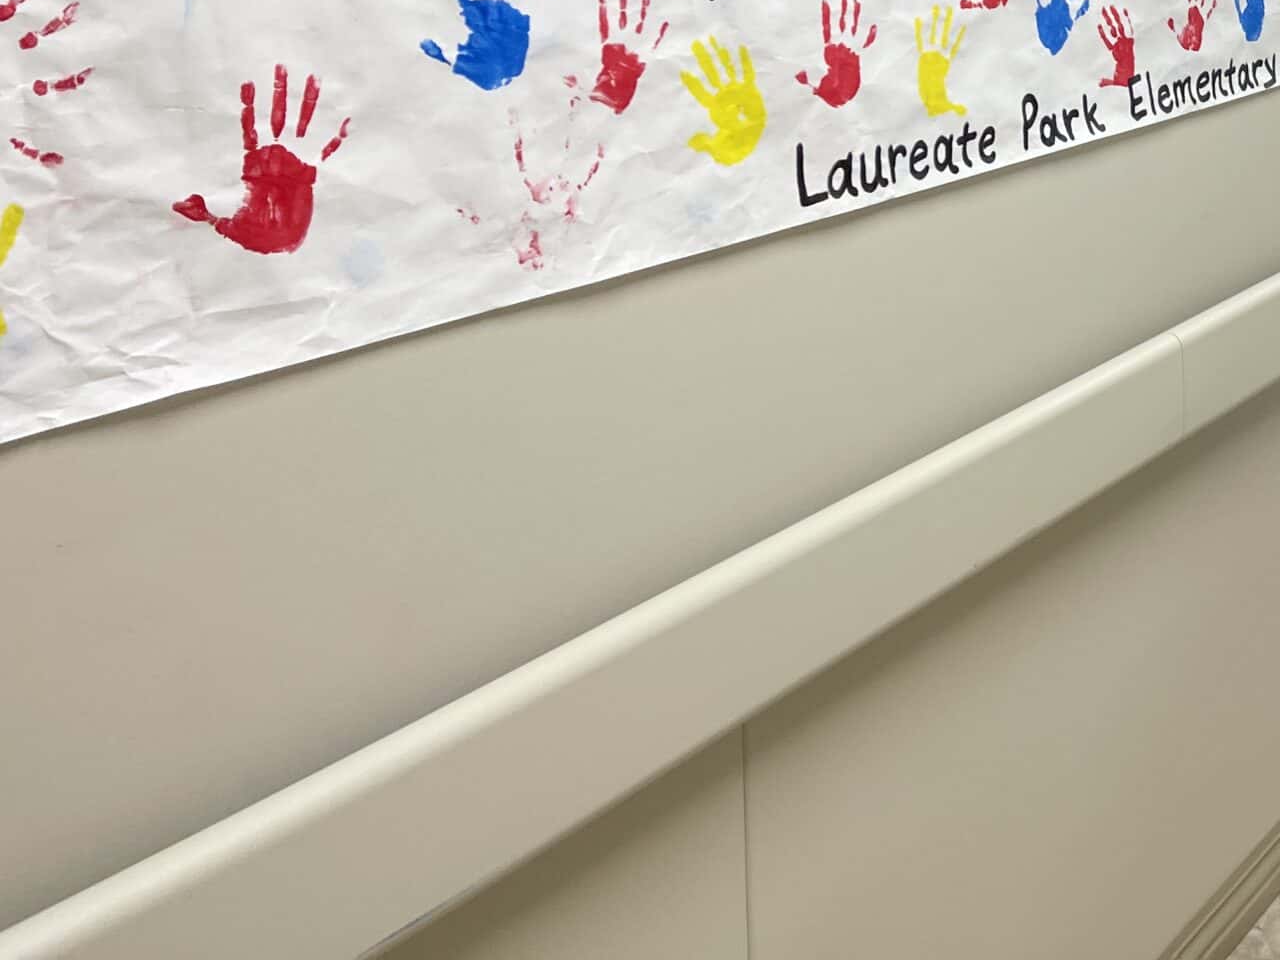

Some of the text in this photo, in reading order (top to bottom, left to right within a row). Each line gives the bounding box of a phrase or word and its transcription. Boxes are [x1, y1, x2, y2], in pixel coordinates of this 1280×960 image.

[795, 53, 1278, 207] Laureate Park Elementary
